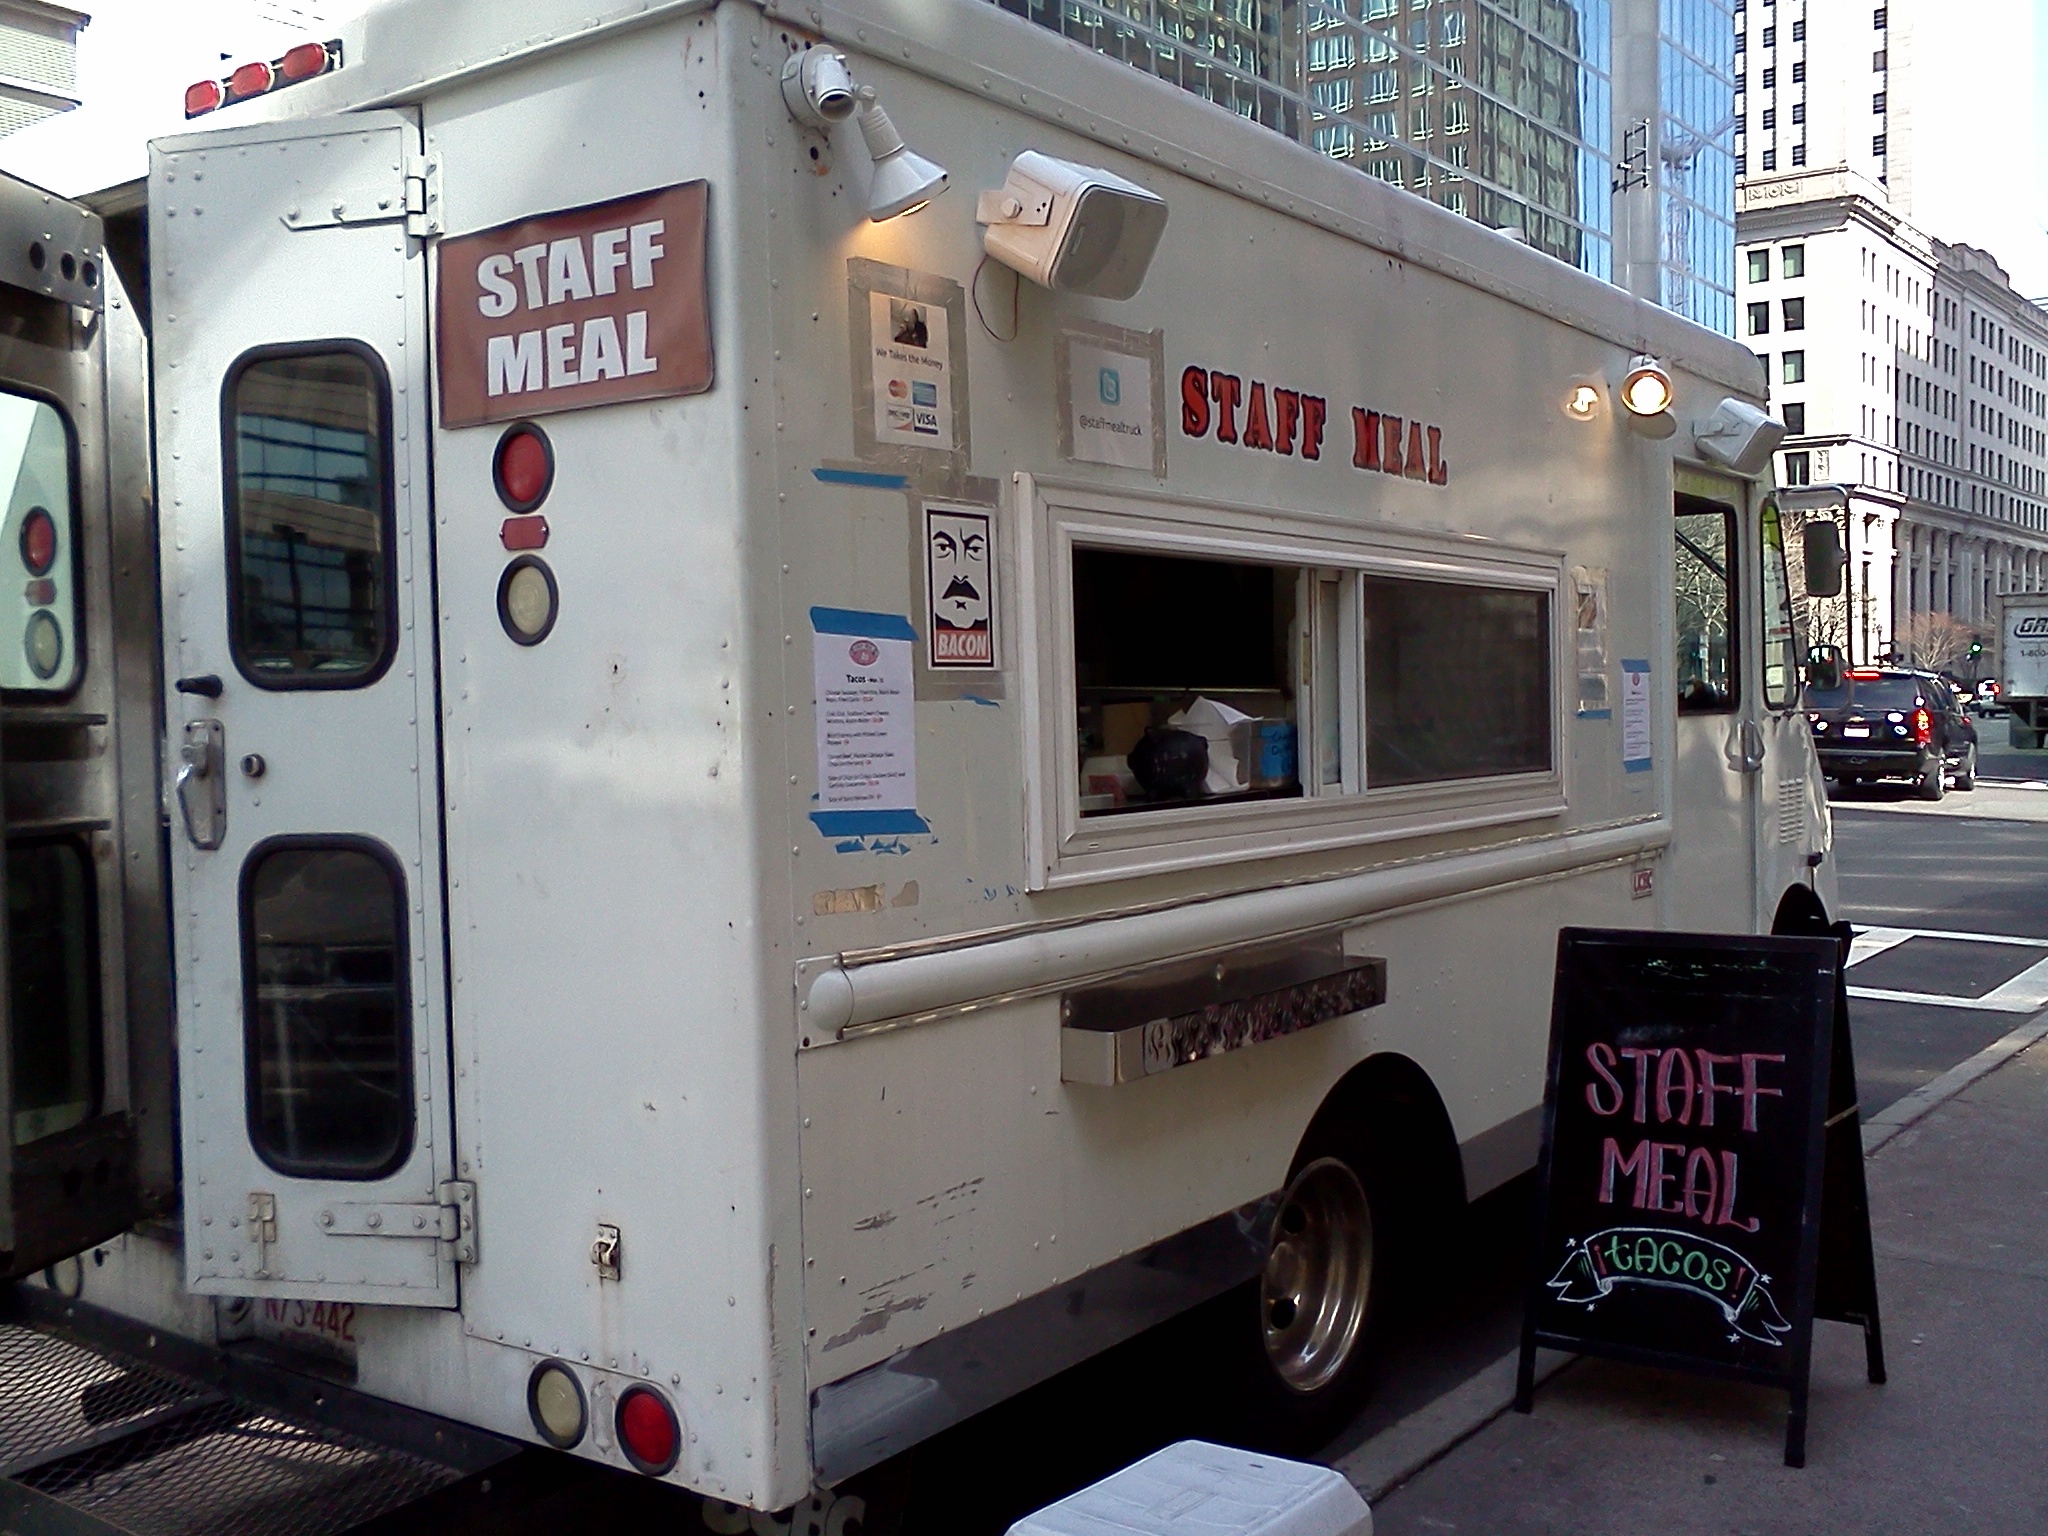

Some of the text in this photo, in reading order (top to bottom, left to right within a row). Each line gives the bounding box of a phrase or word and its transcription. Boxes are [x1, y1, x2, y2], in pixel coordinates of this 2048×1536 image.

[477, 219, 665, 318] STAFF
[487, 310, 657, 397] MEAL
[916, 412, 937, 426] VISA
[1181, 365, 1448, 486] STAFF MEAL
[846, 674, 866, 684] Tacos
[938, 634, 987, 657] BACON
[1586, 1042, 1785, 1132] STAFF
[1599, 1138, 1759, 1232] MEAL
